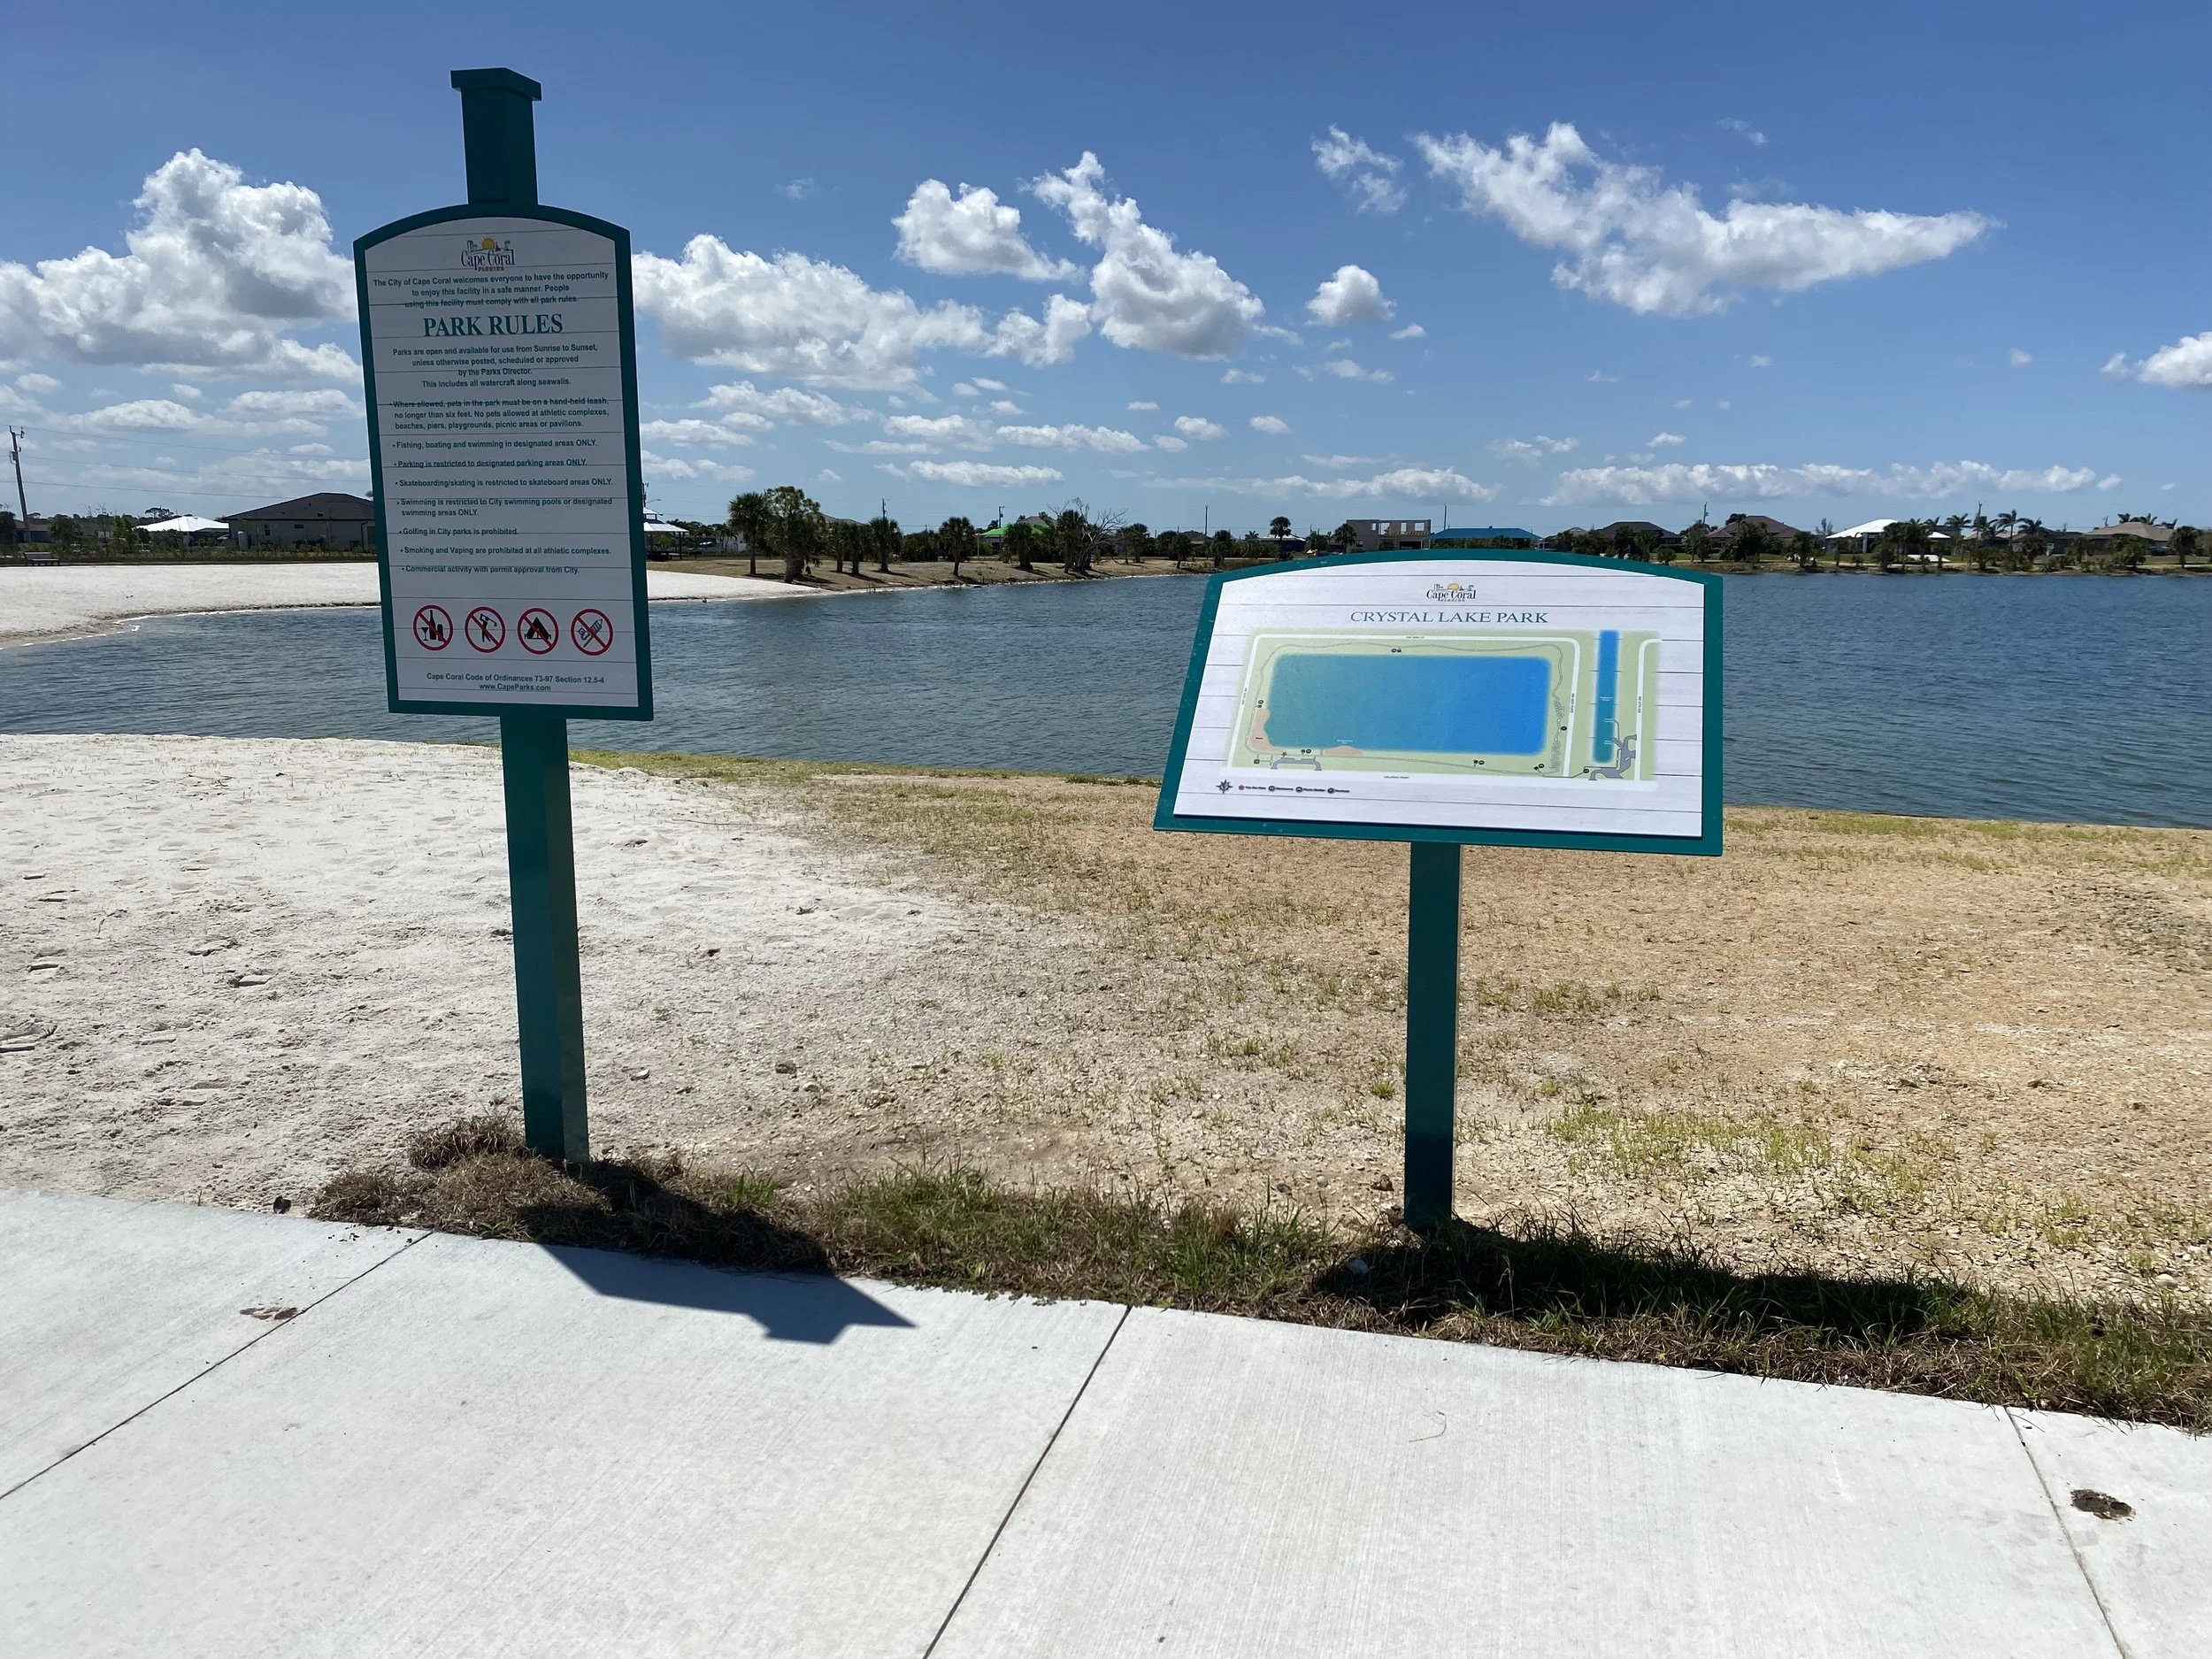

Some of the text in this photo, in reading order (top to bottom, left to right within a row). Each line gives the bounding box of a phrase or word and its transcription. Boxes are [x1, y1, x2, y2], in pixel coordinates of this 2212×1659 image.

[461, 250, 515, 270] Cape Coral
[388, 279, 403, 288] City
[412, 278, 431, 287] Cape
[566, 272, 609, 281] opportunity
[457, 287, 480, 296] facility
[544, 284, 570, 294] People
[405, 300, 424, 310] using
[441, 299, 465, 308] facility
[486, 297, 512, 306] comply
[541, 296, 557, 304] park
[423, 314, 563, 337] PARK RULES
[571, 343, 598, 352] Sunset,
[471, 357, 497, 366] posted,
[545, 355, 579, 365] approved
[458, 369, 467, 378] by
[517, 379, 537, 388] along
[417, 400, 445, 409] allowed,
[447, 400, 462, 409] pets
[485, 399, 501, 408] park
[404, 411, 426, 420] longer
[486, 411, 501, 419] pets
[568, 408, 609, 418] complexes,
[395, 422, 426, 431] beaches,
[427, 422, 447, 431] piers,
[448, 421, 494, 431] playgrounds,
[495, 421, 517, 430] picnic
[425, 441, 451, 449] boating
[467, 440, 503, 449] swimming
[513, 440, 553, 449] designated
[398, 460, 424, 469] Parking
[476, 459, 515, 468] designated
[517, 459, 543, 468] parking
[399, 479, 475, 488] Skateboarding/skating
[401, 498, 436, 507] Swimming
[488, 498, 503, 507] City
[504, 498, 540, 507] swimming
[541, 498, 562, 507] pools
[572, 498, 612, 507] designated
[402, 509, 436, 518] swimming
[403, 527, 428, 536] Golfing
[437, 528, 451, 537] City
[453, 528, 472, 537] parks
[404, 547, 434, 556] Smoking
[449, 547, 474, 556] Vaping
[488, 547, 524, 556] prohibited
[571, 548, 611, 557] complexes.
[448, 565, 472, 574] activity
[490, 565, 512, 574] permit
[514, 566, 544, 575] approval
[564, 566, 580, 575] City.
[1426, 589, 1477, 601] Cape Coral
[1350, 611, 1549, 624] CRYSTAL LAKE PARK
[426, 673, 444, 682] Cape
[479, 683, 551, 692] www.CapeParks.com
